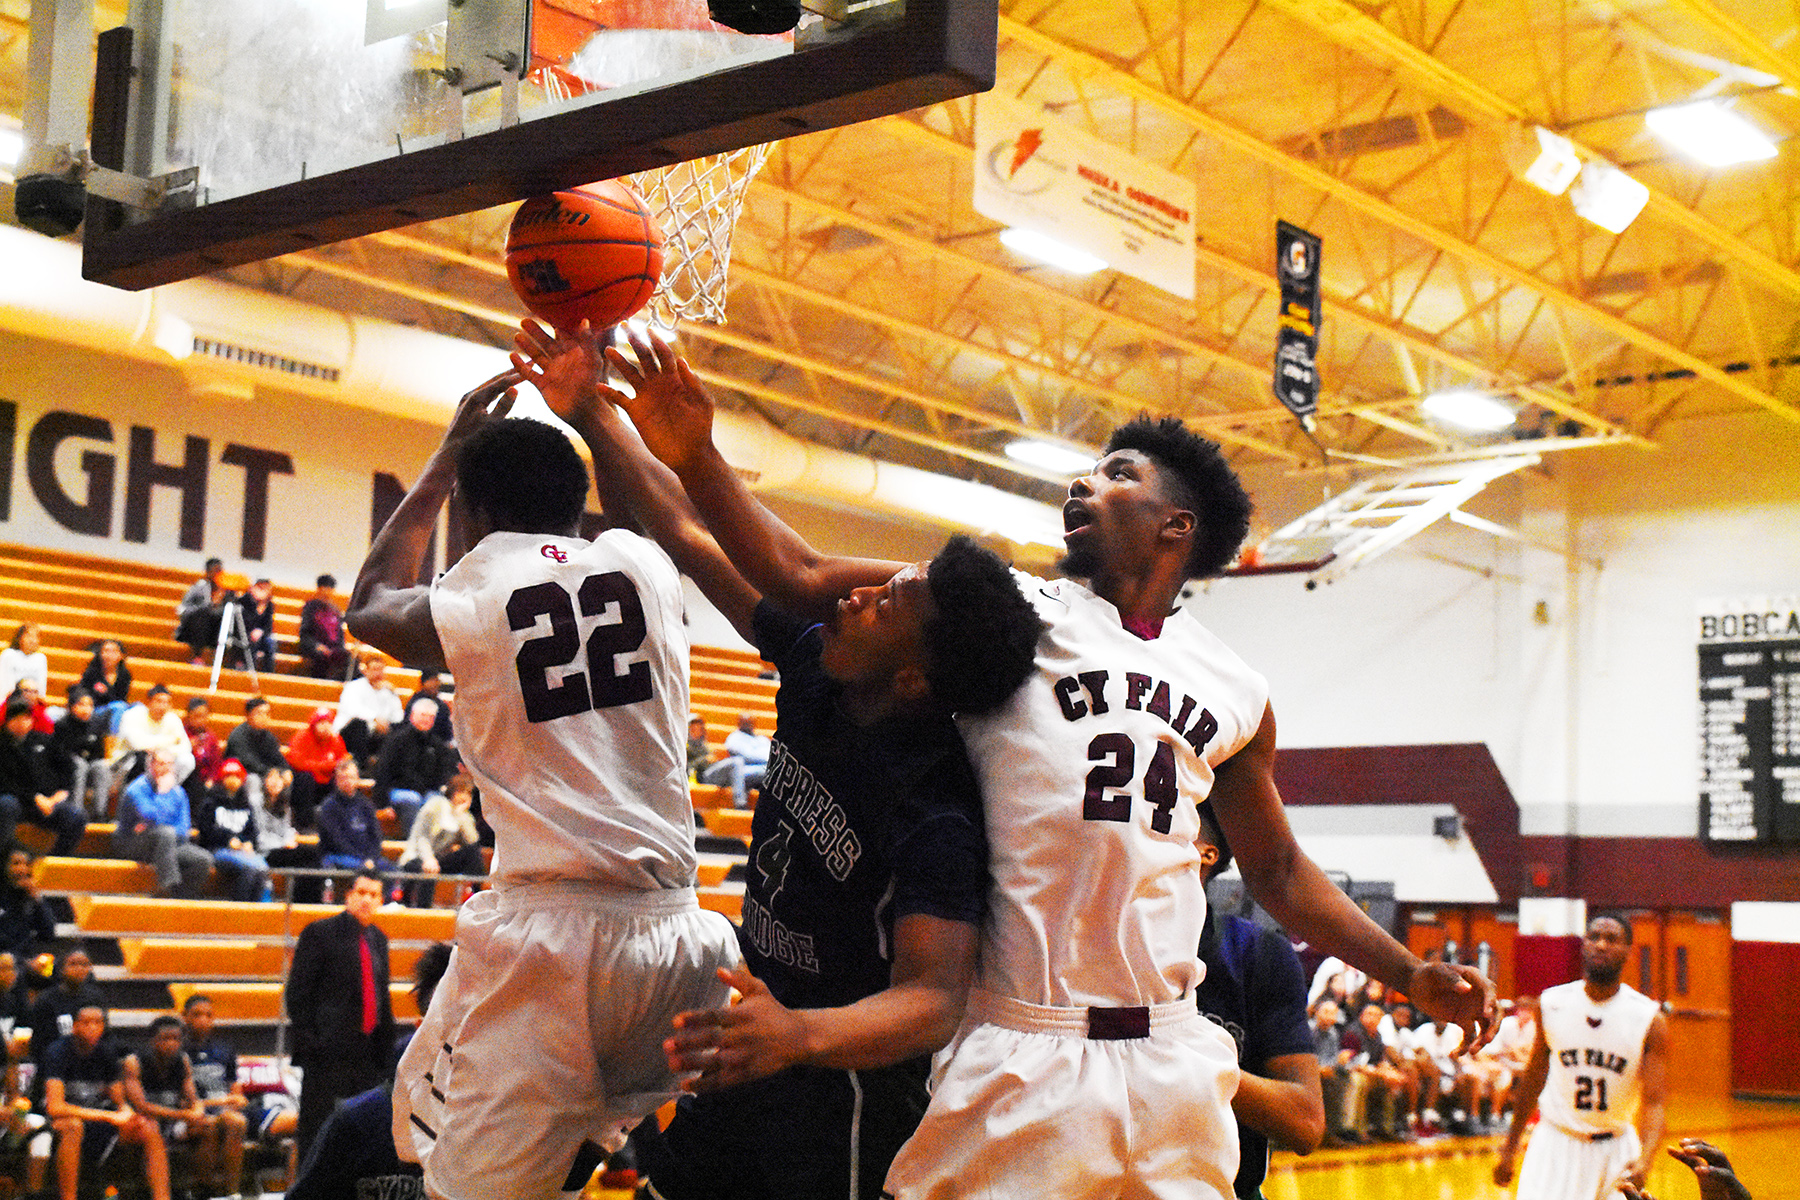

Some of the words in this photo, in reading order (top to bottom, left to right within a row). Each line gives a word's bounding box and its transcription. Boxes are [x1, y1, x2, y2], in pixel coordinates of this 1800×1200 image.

[506, 571, 653, 723] 22
[1054, 670, 1110, 722] CY
[1125, 672, 1218, 758] FAIR
[763, 737, 862, 882] YPRESS
[1083, 732, 1178, 835] 24
[1574, 1075, 1608, 1111] 21
